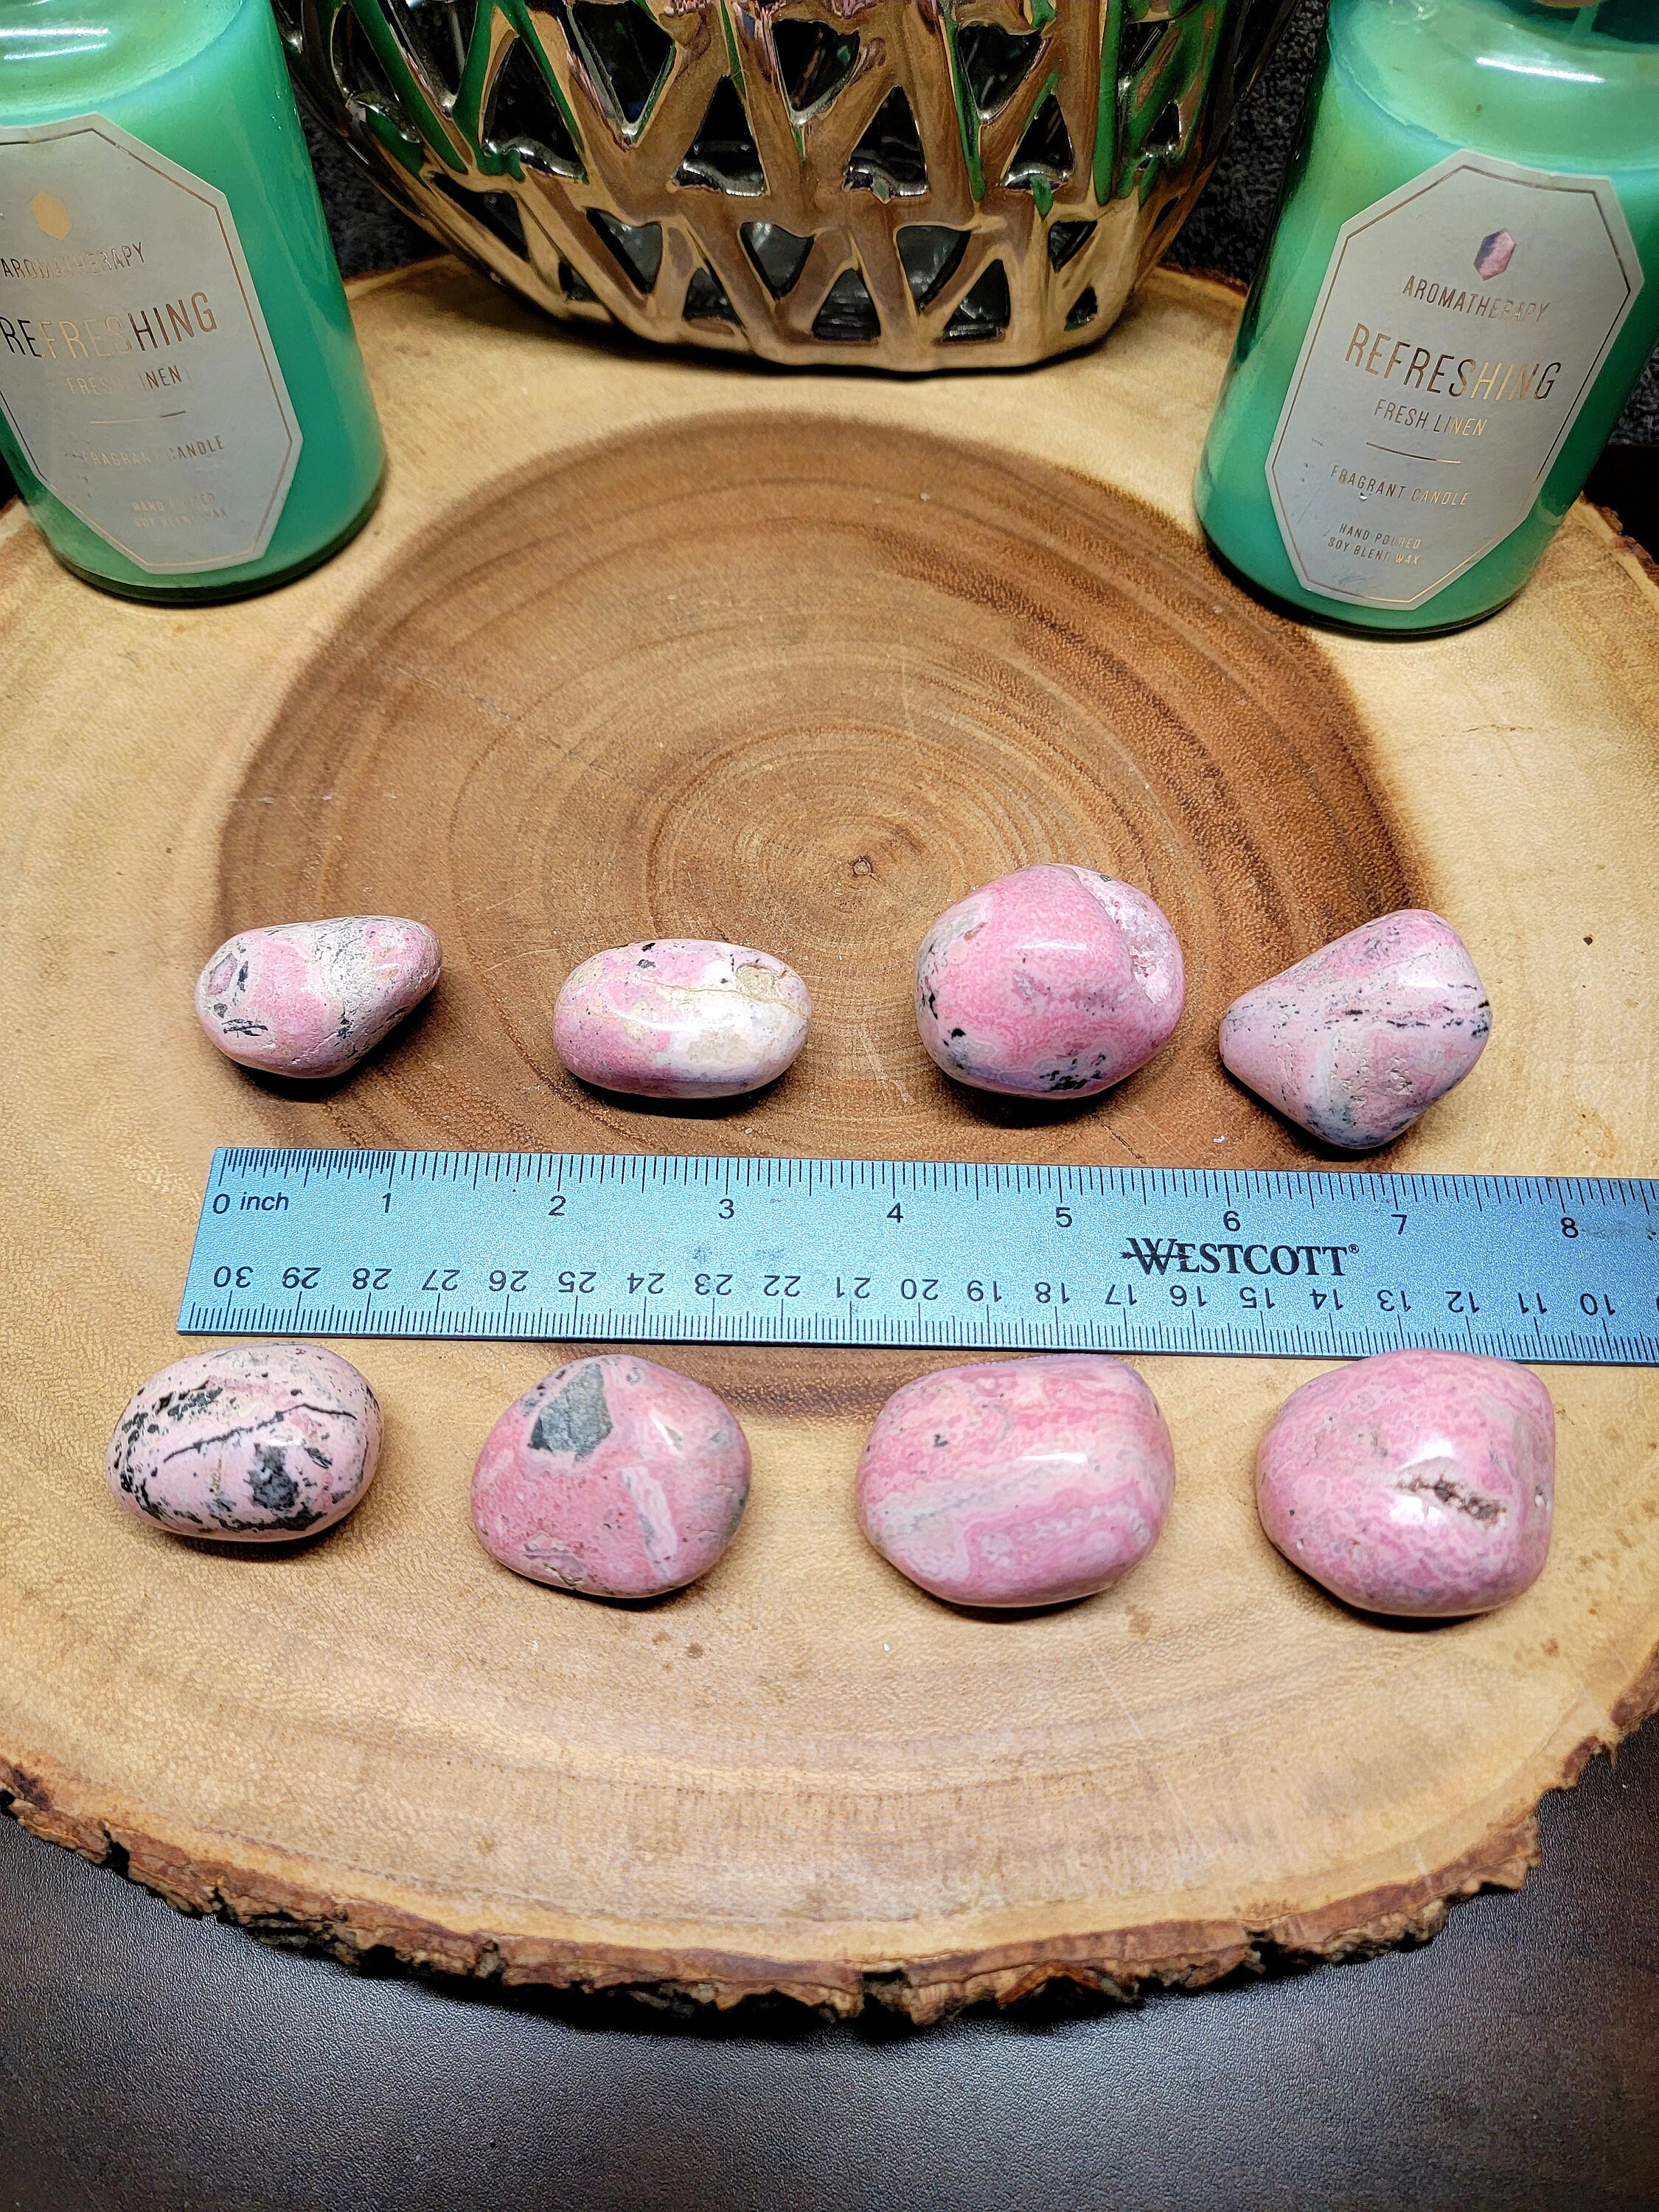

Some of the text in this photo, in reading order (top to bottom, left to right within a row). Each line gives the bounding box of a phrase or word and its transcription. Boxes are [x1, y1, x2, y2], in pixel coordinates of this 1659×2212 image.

[1, 241, 145, 279] AROMATHERAPY
[1402, 275, 1549, 322] AROMATHERAPY
[0, 291, 218, 359] REFRESHING
[1345, 322, 1562, 401] REFRESHING
[1374, 399, 1488, 437] FRESH LINEN
[1330, 464, 1472, 506] FRAGRANT CANDLE
[1328, 536, 1421, 566] SOY BLEND WAX
[1338, 522, 1422, 550] HAND POURED
[212, 1192, 1579, 1239] 0 inch 1 2 3 4 5 6 7 8
[214, 1266, 1616, 1316] 10 11 12 13 14 15 16 17 18 19 20 21 22 23 24 25 26 27 28 29 30
